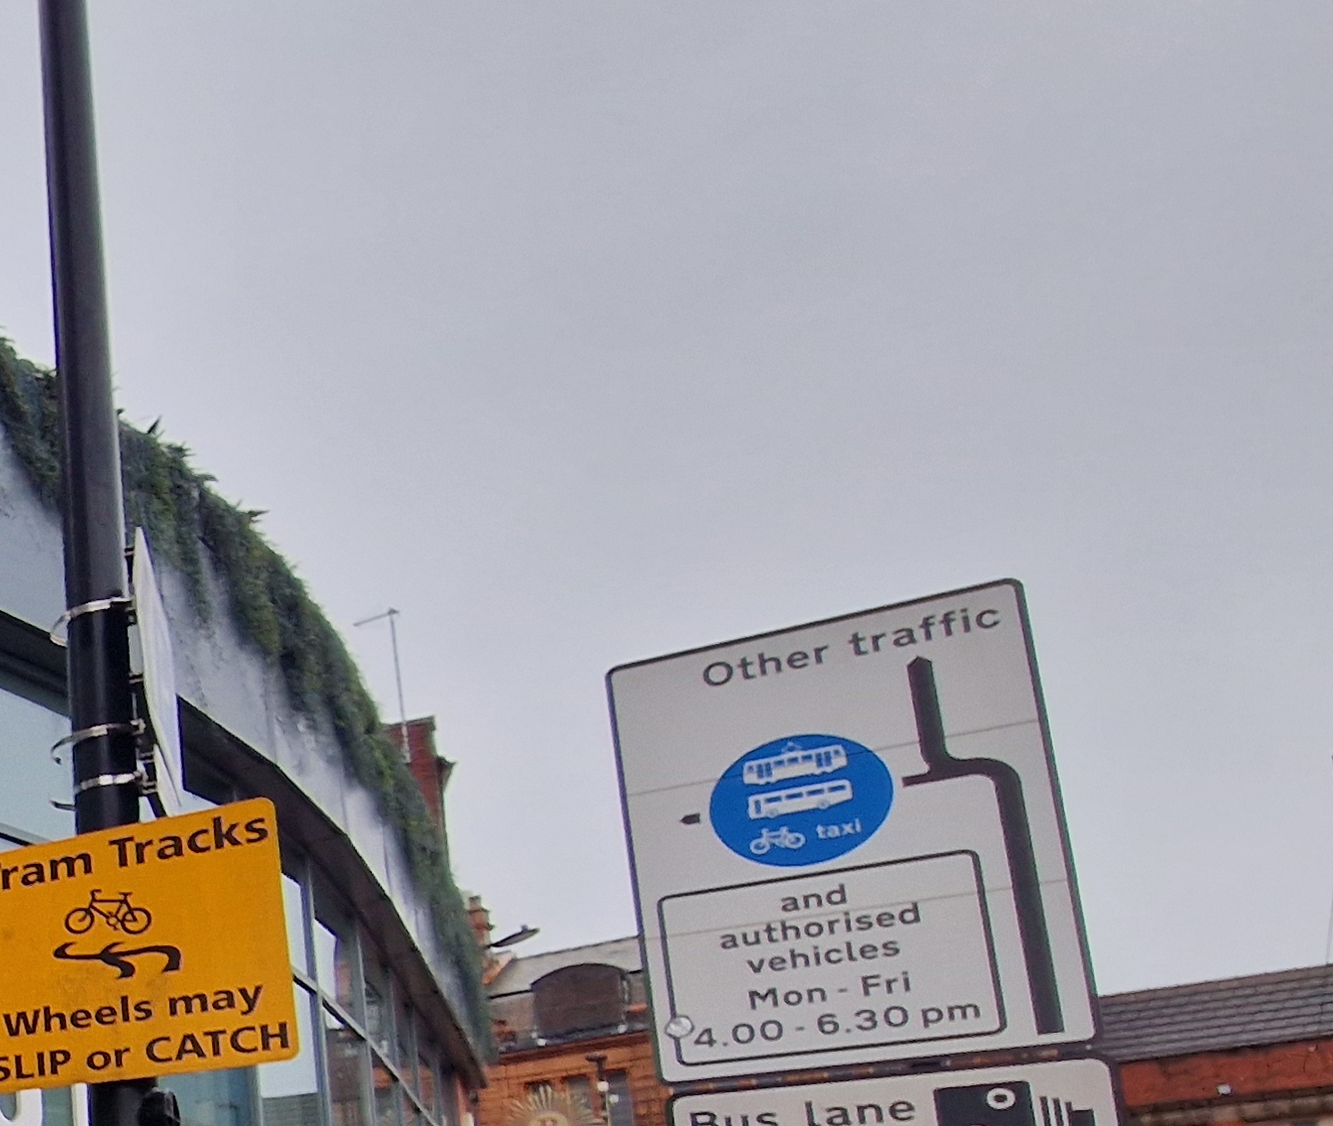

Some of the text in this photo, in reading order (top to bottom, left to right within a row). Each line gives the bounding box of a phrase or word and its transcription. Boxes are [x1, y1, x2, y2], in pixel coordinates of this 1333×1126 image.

[702, 606, 1003, 688] Other traffic
[109, 816, 269, 868] Tracks
[816, 818, 862, 839] taxi
[780, 883, 847, 913] and
[720, 902, 922, 951] authorised
[746, 936, 901, 974] vehicles
[2, 984, 264, 1038] Wheels may
[748, 985, 827, 1011] Mon
[860, 971, 912, 998] Fri
[86, 1045, 131, 1072] or
[145, 1021, 291, 1064] CATCH
[693, 1018, 785, 1050] 4.00
[817, 1004, 910, 1036] 6.30
[920, 1001, 982, 1030] pm
